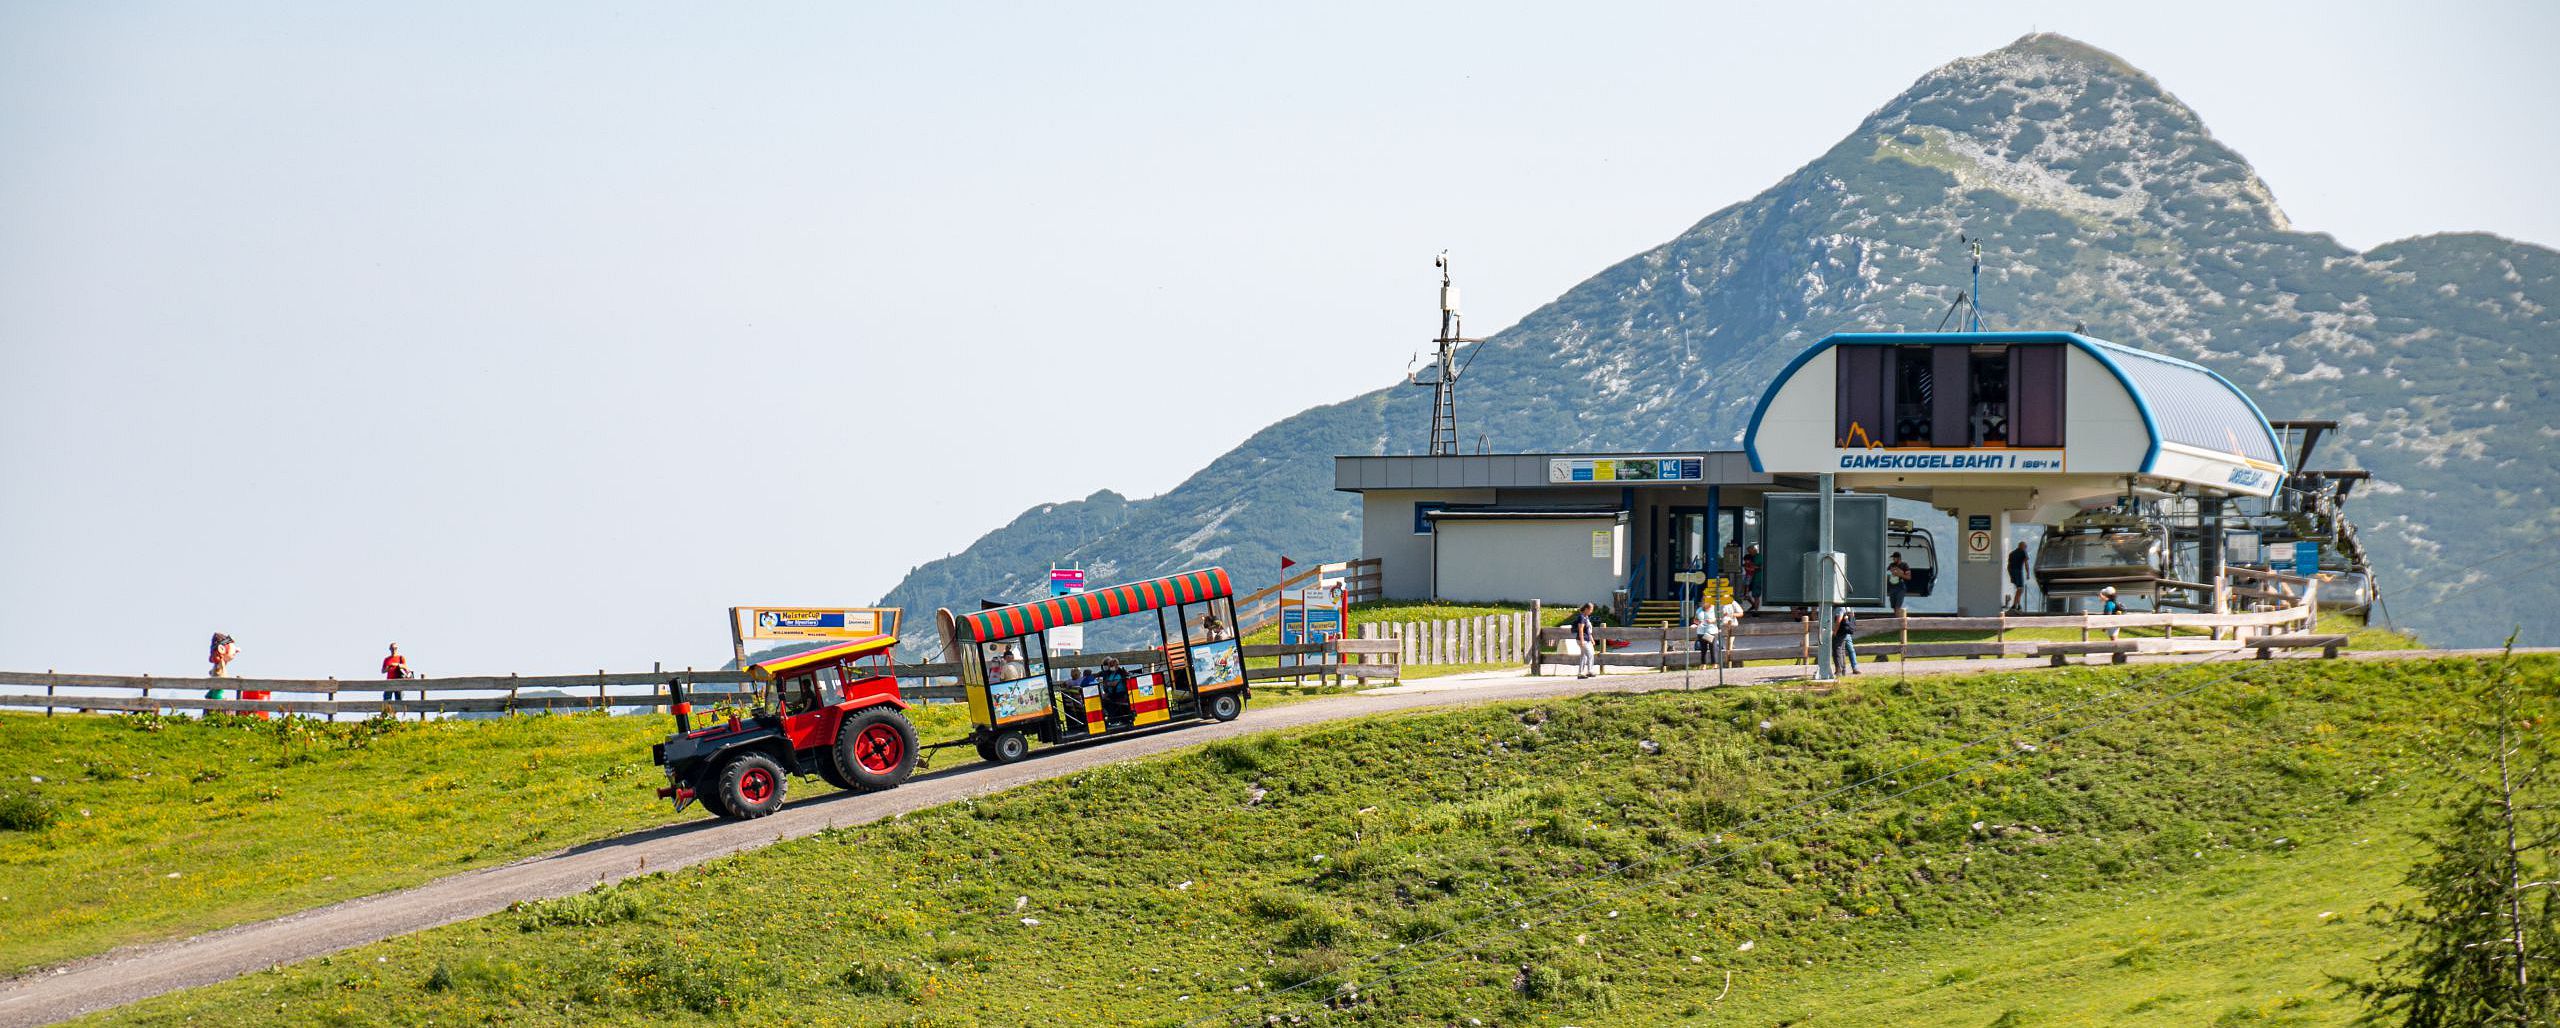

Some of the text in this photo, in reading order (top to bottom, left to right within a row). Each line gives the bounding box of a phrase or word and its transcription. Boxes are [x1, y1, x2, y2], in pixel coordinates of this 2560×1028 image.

[1662, 460, 1677, 471] WC
[1840, 455, 2003, 469] GAMSKOGELBAHN
[2022, 460, 2047, 469] 1884
